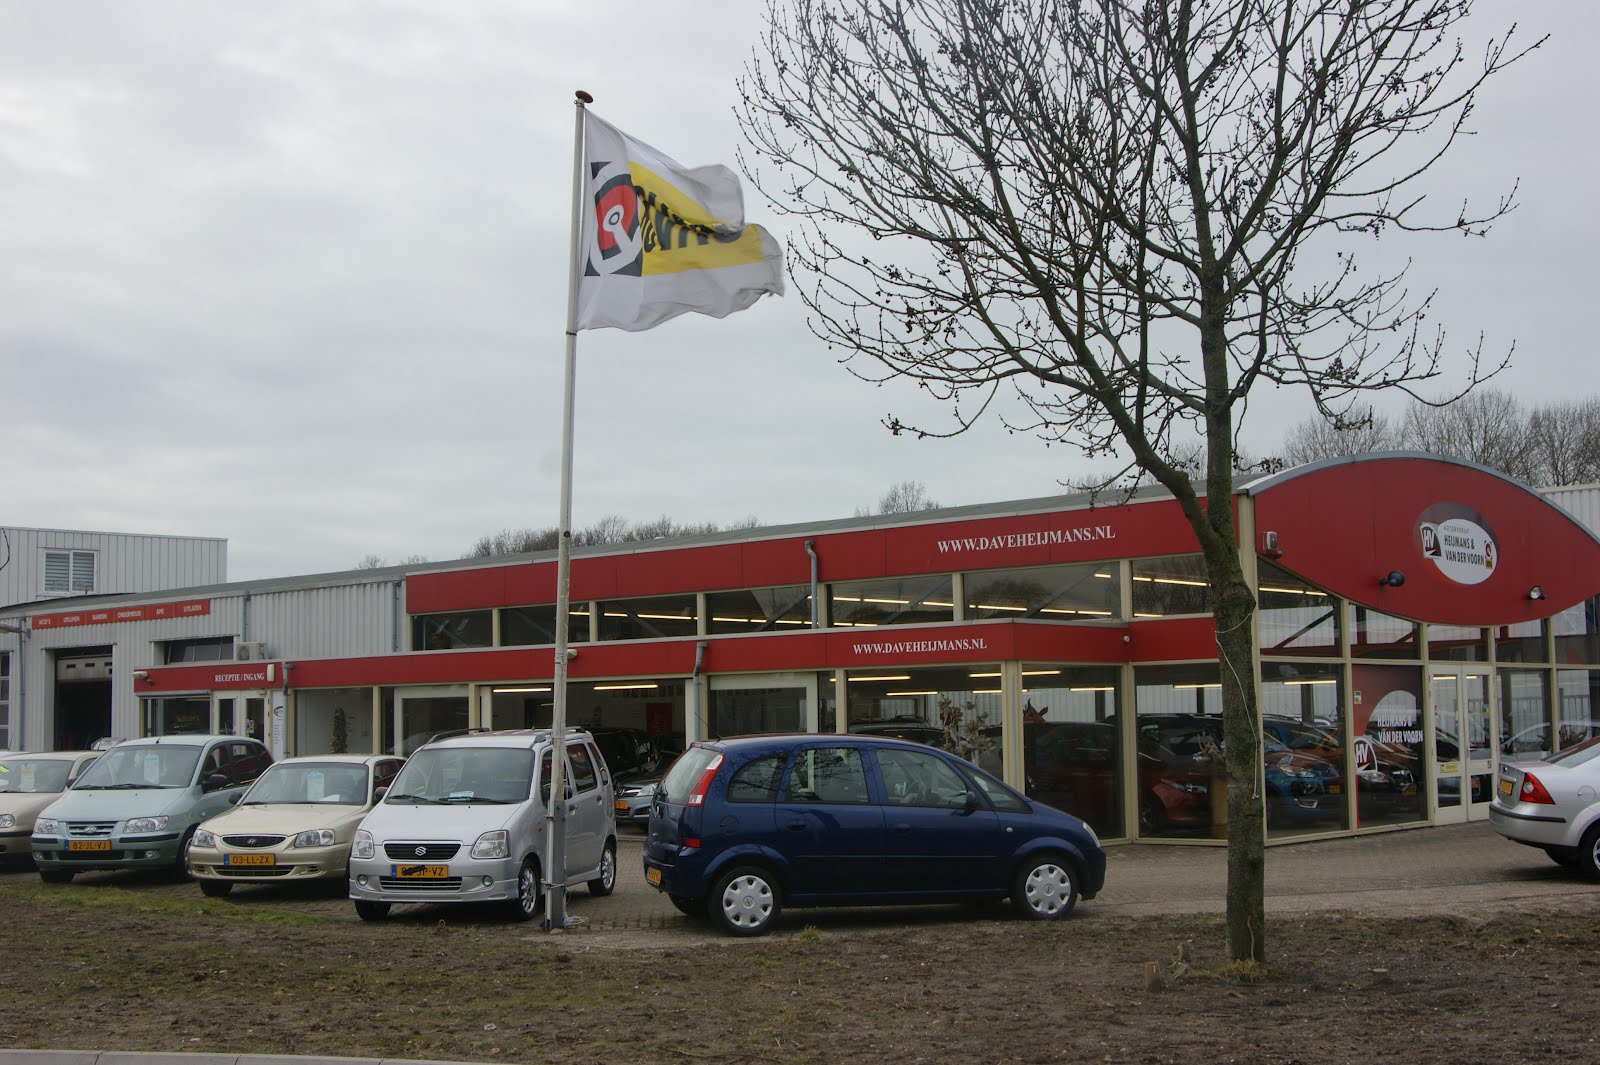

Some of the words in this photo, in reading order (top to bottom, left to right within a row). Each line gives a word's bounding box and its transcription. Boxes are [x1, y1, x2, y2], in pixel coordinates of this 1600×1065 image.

[937, 525, 1116, 553] WWW.DAVEHEIJMANS.NL
[1444, 535, 1470, 549] HEIJMANS
[1471, 539, 1475, 550] &
[1445, 549, 1456, 561] VAN
[1457, 552, 1466, 563] DER
[1467, 553, 1485, 566] VOORN
[117, 610, 141, 619] ONDERHOUD
[853, 638, 987, 655] WWW.DAVEHEIJMANS.NL
[214, 673, 240, 682] RECEPTIE
[244, 673, 265, 681] INGANG
[1377, 714, 1407, 727] HEIJMANS
[1378, 731, 1391, 744] VAN
[1391, 731, 1403, 743] DER
[1403, 730, 1423, 743] VOORN
[1355, 743, 1368, 763] HV
[232, 856, 270, 864] 03-LL-ZX
